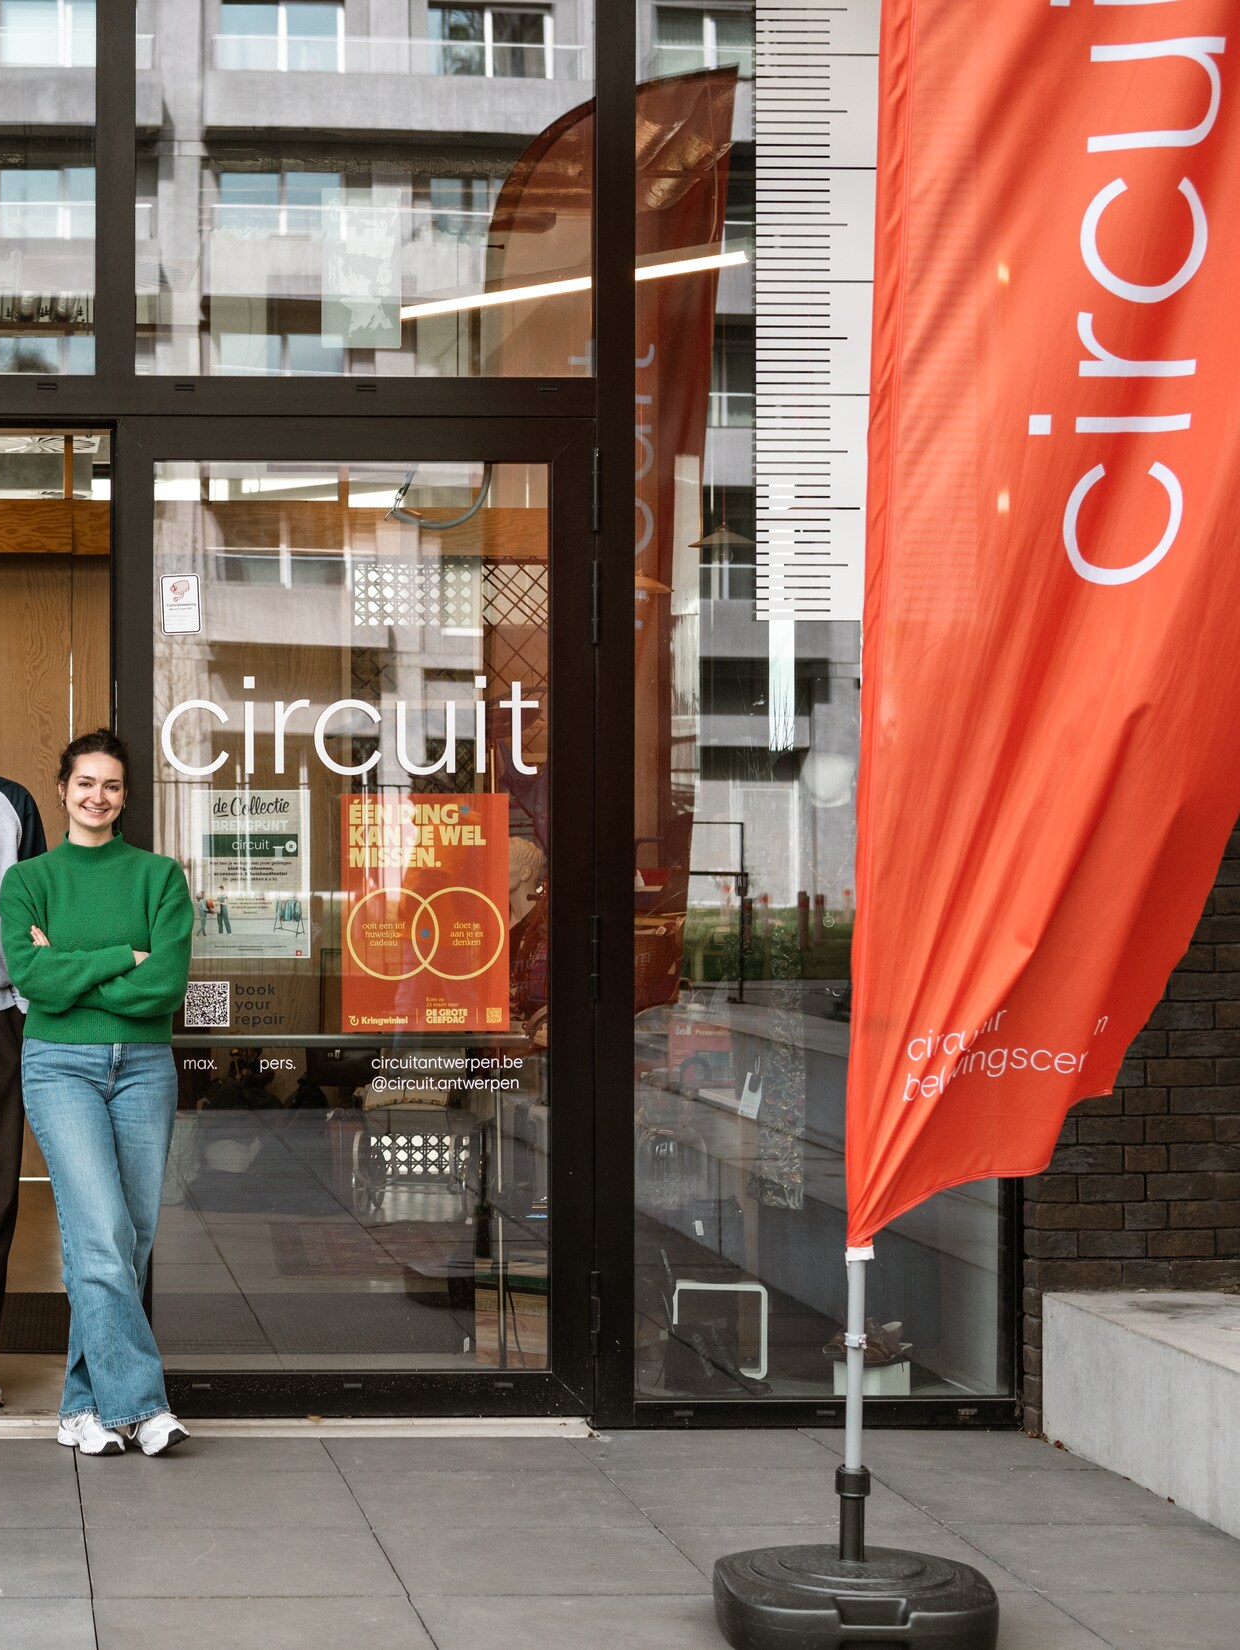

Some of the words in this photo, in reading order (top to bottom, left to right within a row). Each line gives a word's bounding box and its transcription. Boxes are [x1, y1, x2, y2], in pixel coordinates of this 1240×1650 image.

[160, 675, 540, 775] circuit
[213, 797, 229, 818] de
[230, 796, 290, 816] Collectie
[349, 799, 393, 825] ÉÉN
[399, 803, 459, 825] DING
[349, 825, 401, 846] KAN
[407, 825, 434, 846] JE
[439, 825, 487, 846] WEL
[232, 839, 269, 850] circuit
[349, 847, 442, 868] MISSEN.
[362, 922, 377, 930] ooit
[395, 922, 406, 930] tof
[453, 921, 470, 929] doet
[472, 922, 480, 931] je
[365, 930, 403, 939] huwelijks-
[466, 930, 474, 939] je
[369, 938, 398, 946] cadeau
[452, 938, 481, 946] denken
[235, 983, 276, 995] book
[234, 1000, 271, 1013] your
[235, 1013, 285, 1027] repair
[361, 1016, 408, 1025] Kringwinkel
[426, 1016, 465, 1024] GEEFDAG
[183, 1059, 218, 1070] max.
[260, 1059, 296, 1073] pers.
[371, 1055, 523, 1072] circuitantwerpen.be
[371, 1076, 520, 1093] @circuit.antwerpen
